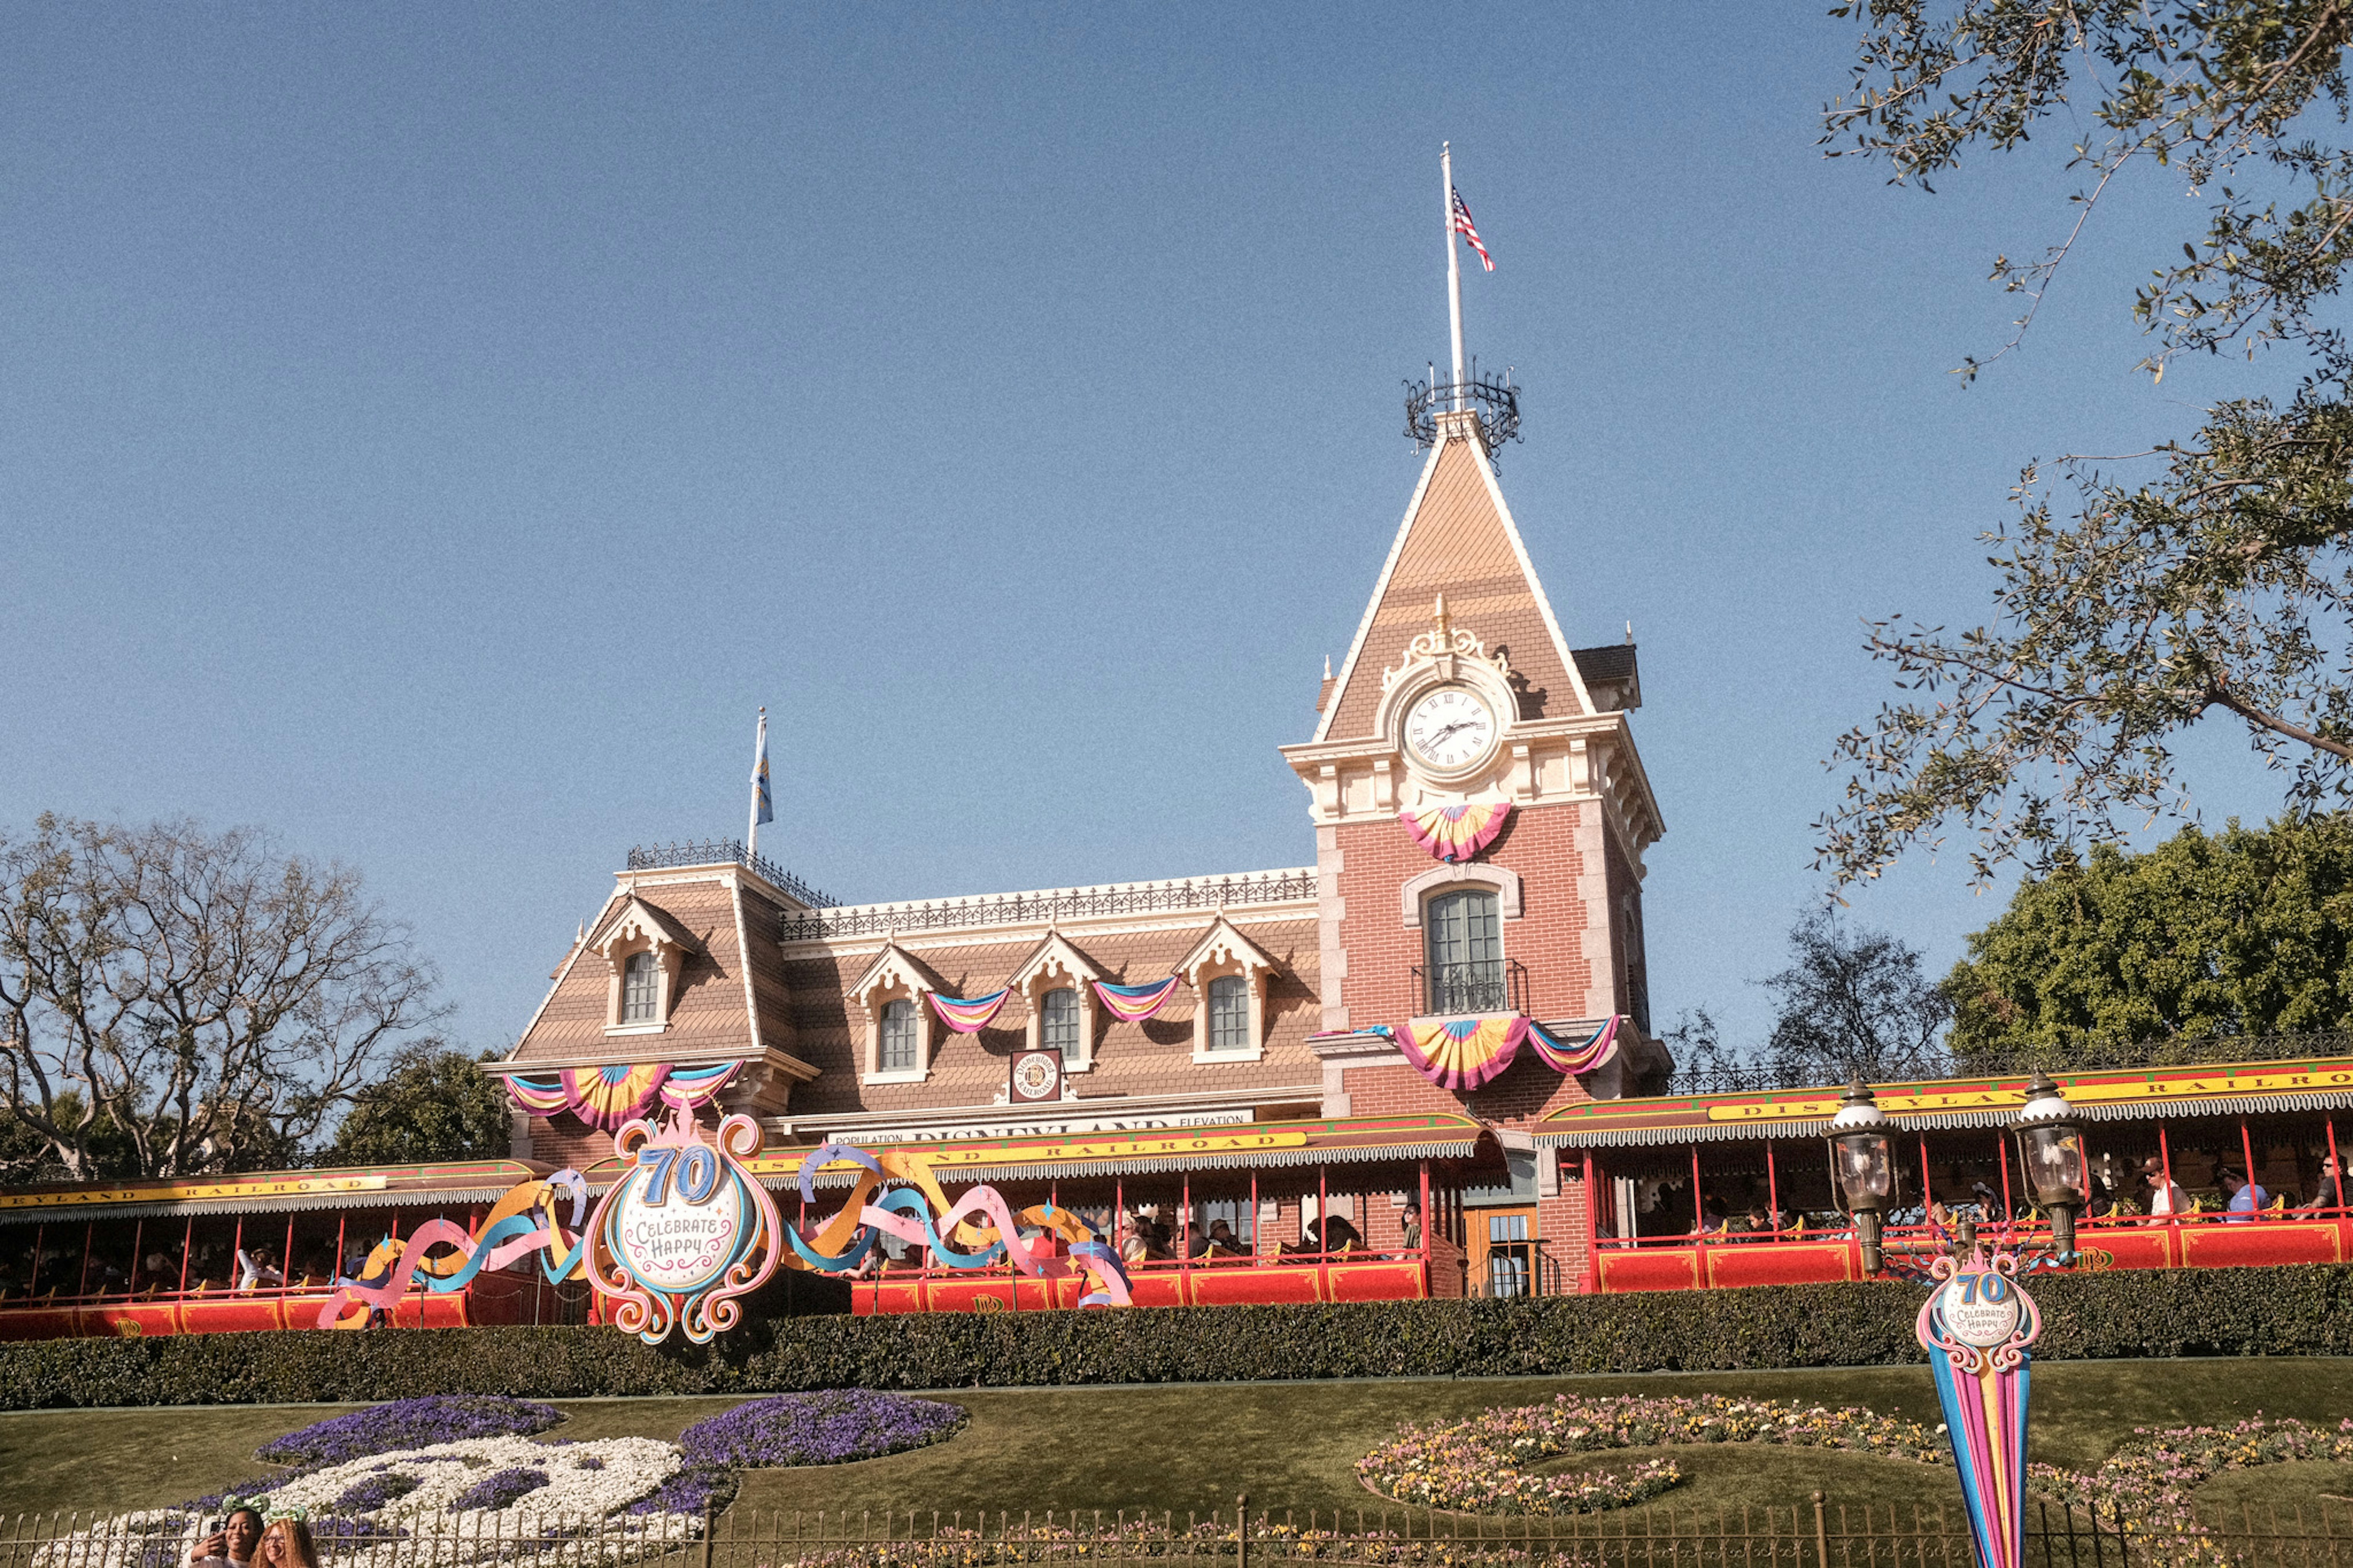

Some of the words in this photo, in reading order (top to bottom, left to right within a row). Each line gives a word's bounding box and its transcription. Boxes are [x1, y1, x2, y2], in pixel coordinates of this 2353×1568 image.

[1016, 1056, 1055, 1075] Disneyland
[1018, 1079, 1053, 1096] RAILROAD
[836, 1134, 903, 1144] POPULATION
[1180, 1115, 1243, 1126] ELEVATION
[1046, 1136, 1275, 1156] RAILROAD
[637, 1143, 721, 1207] 70
[0, 1192, 135, 1205] EYLAND
[185, 1180, 362, 1196] RAILROAD
[636, 1219, 717, 1244] CELEBRATE
[651, 1238, 702, 1259] HAPPY
[1954, 1271, 2008, 1305] 70
[1957, 1309, 2006, 1322] CELEBRATE
[1968, 1319, 1998, 1330] HAPPY
